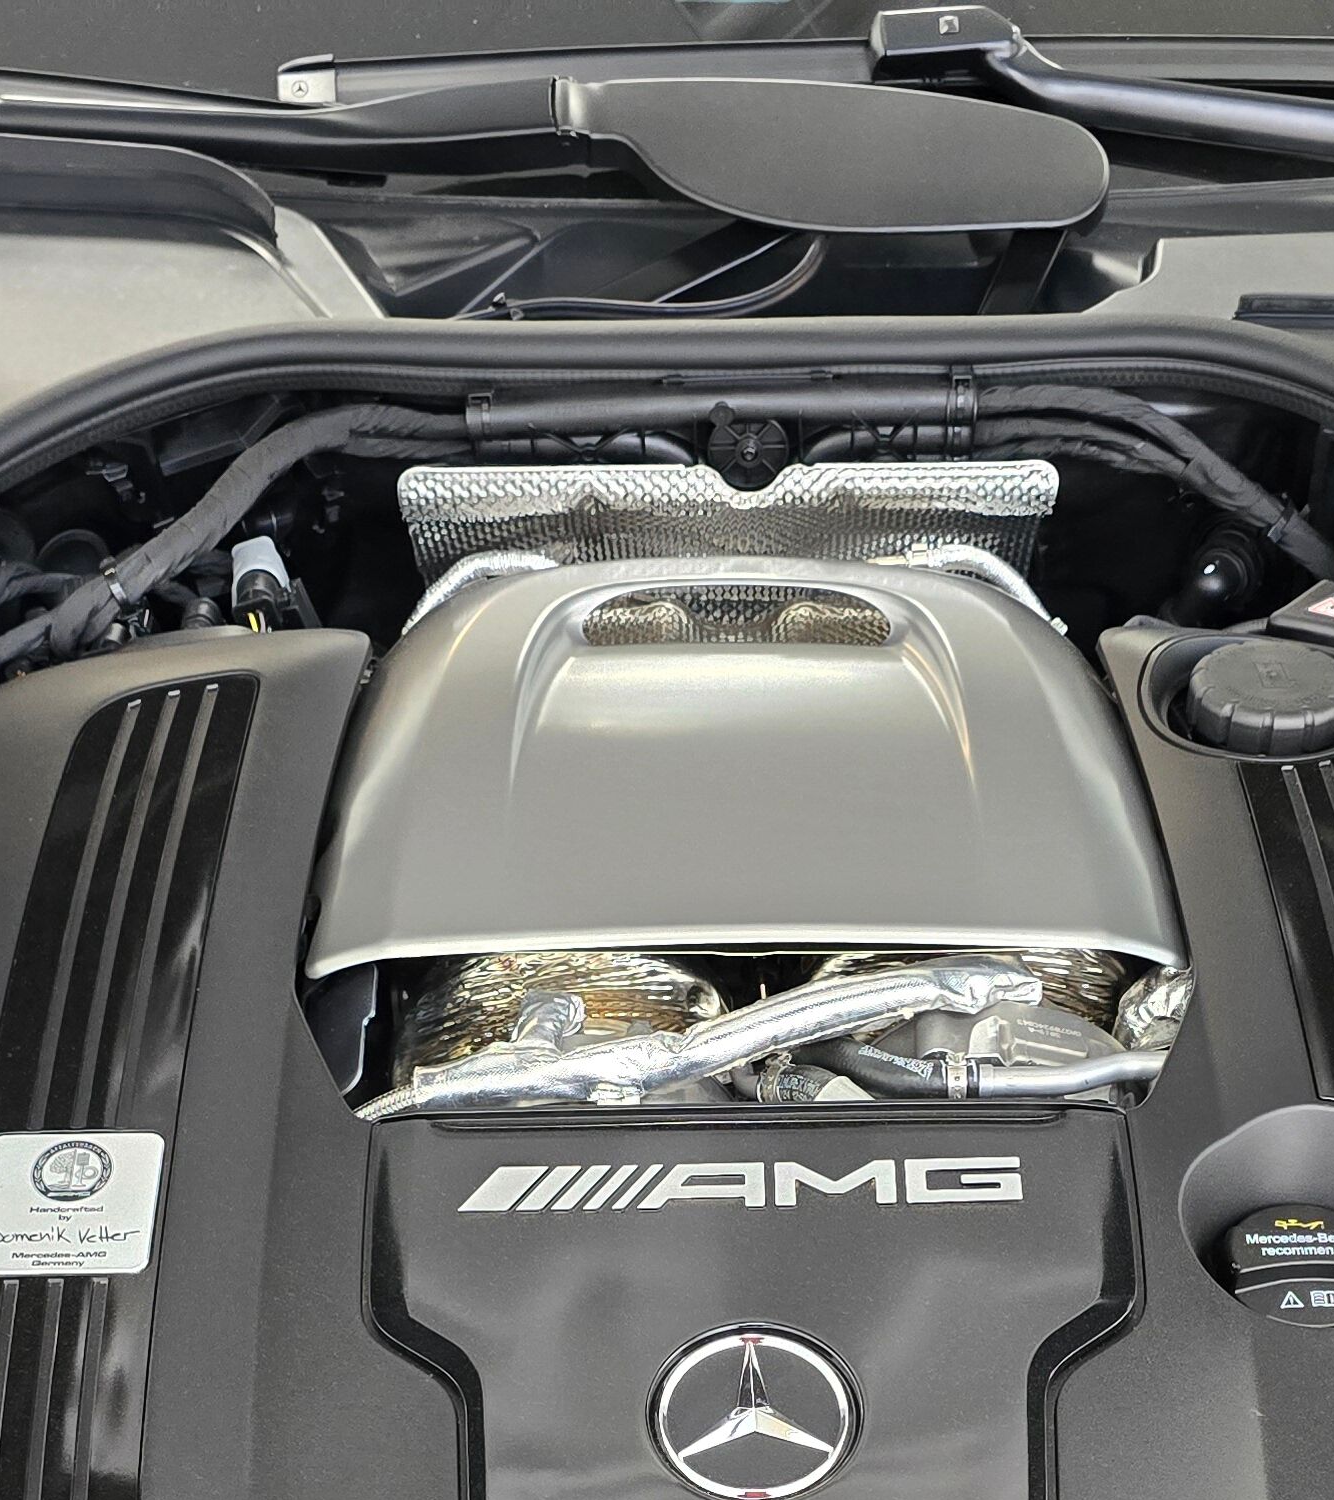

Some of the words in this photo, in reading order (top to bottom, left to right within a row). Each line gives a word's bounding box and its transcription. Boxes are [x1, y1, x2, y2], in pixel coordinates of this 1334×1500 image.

[638, 1157, 1024, 1210] AMG
[29, 1206, 104, 1214] Handcrafted
[58, 1214, 72, 1222] by
[11, 1251, 107, 1259] Mercedes-AMG
[31, 1260, 84, 1268] Germany
